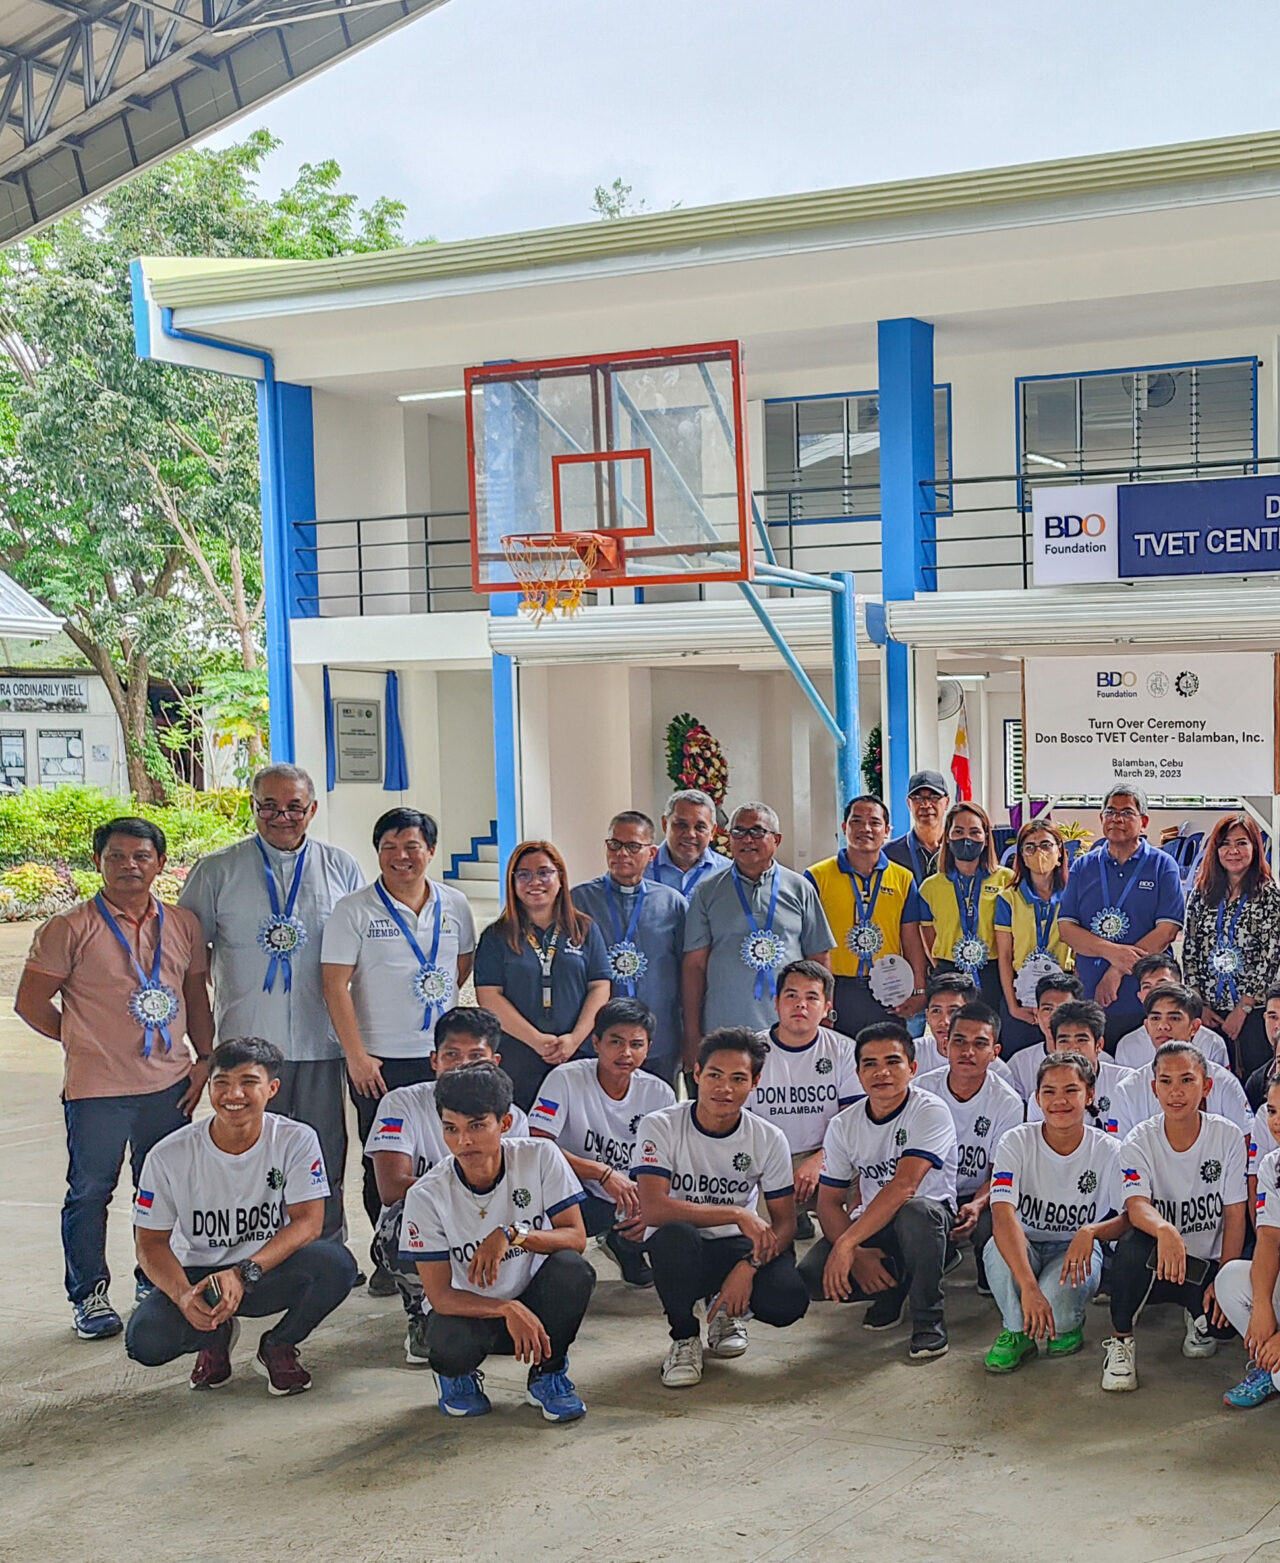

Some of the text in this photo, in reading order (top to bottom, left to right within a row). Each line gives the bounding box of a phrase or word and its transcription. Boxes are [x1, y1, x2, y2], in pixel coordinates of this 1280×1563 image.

[1044, 513, 1106, 539] BDO
[1044, 542, 1107, 555] Foundation
[1134, 531, 1200, 557] TVET
[1096, 671, 1138, 688] BDO
[13, 683, 59, 696] ORDINARILY
[60, 684, 84, 696] WELL
[1096, 689, 1138, 698] Foundation
[1088, 717, 1207, 731] Turn Over Ceremony
[1035, 732, 1058, 744] Don
[1060, 732, 1093, 744] Bosco
[1096, 732, 1127, 743] TVET
[1129, 731, 1169, 743] Center
[1178, 731, 1239, 744] Balamban,
[1242, 731, 1265, 743] Inc.
[1112, 758, 1184, 769] Balamban, Cebu
[1114, 769, 1182, 779] March 29, 2023
[367, 929, 400, 938] JIEMBO
[756, 1084, 837, 1104] DON BOSCO
[769, 1105, 824, 1116] BALAMBAN
[699, 1174, 749, 1195] BOSCO
[1045, 1201, 1097, 1226] BOSCO
[1181, 1191, 1223, 1227] BOSCO
[193, 1208, 230, 1238] DON
[1021, 1218, 1082, 1232] BALAMBA
[1180, 1220, 1217, 1235] AMBAN
